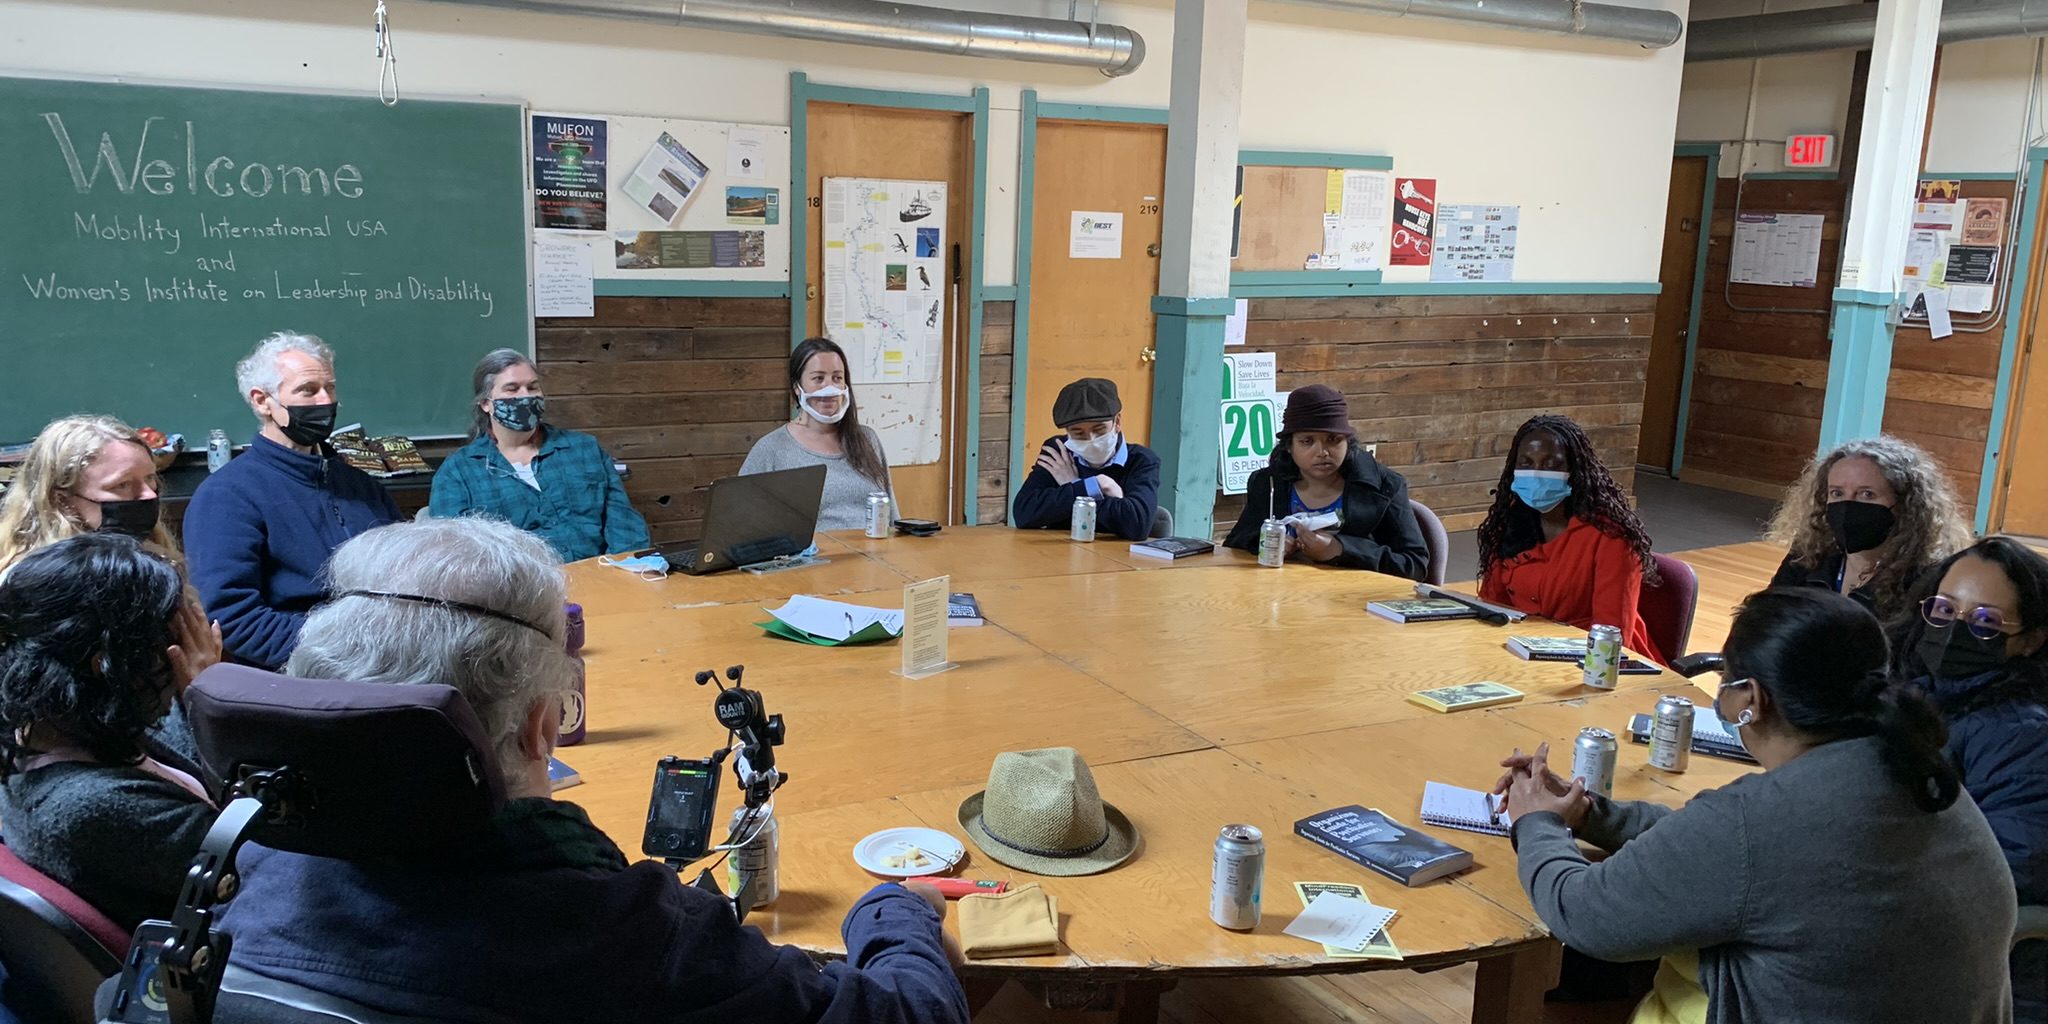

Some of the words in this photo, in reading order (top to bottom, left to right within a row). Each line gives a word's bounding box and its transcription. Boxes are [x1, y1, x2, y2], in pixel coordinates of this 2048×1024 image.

[547, 122, 594, 136] MUFON
[38, 112, 364, 198] Welcome
[1792, 136, 1827, 164] EXIT
[535, 188, 549, 196] DO
[550, 189, 568, 197] YOU
[569, 190, 604, 199] BELIEVE?
[807, 197, 820, 208] 18
[1140, 205, 1159, 215] 219
[1094, 222, 1113, 230] BEST
[74, 211, 181, 255] Mobility
[200, 212, 331, 239] International
[346, 219, 389, 237] USA
[196, 250, 236, 272] and
[22, 272, 131, 302] Women's
[145, 276, 229, 303] Institute
[242, 287, 266, 299] on
[274, 270, 368, 308] Leadership
[374, 282, 402, 301] and
[408, 276, 493, 318] Disability
[1238, 360, 1253, 368] Slow
[1255, 359, 1273, 367] Down
[1238, 370, 1253, 378] Save
[1254, 369, 1270, 378] Lives
[1225, 403, 1273, 458] 20
[1232, 461, 1240, 471] IS
[1228, 476, 1238, 485] ES
[719, 701, 745, 714] RAM
[1308, 811, 1360, 828] Organizing
[1320, 821, 1350, 833] Guide
